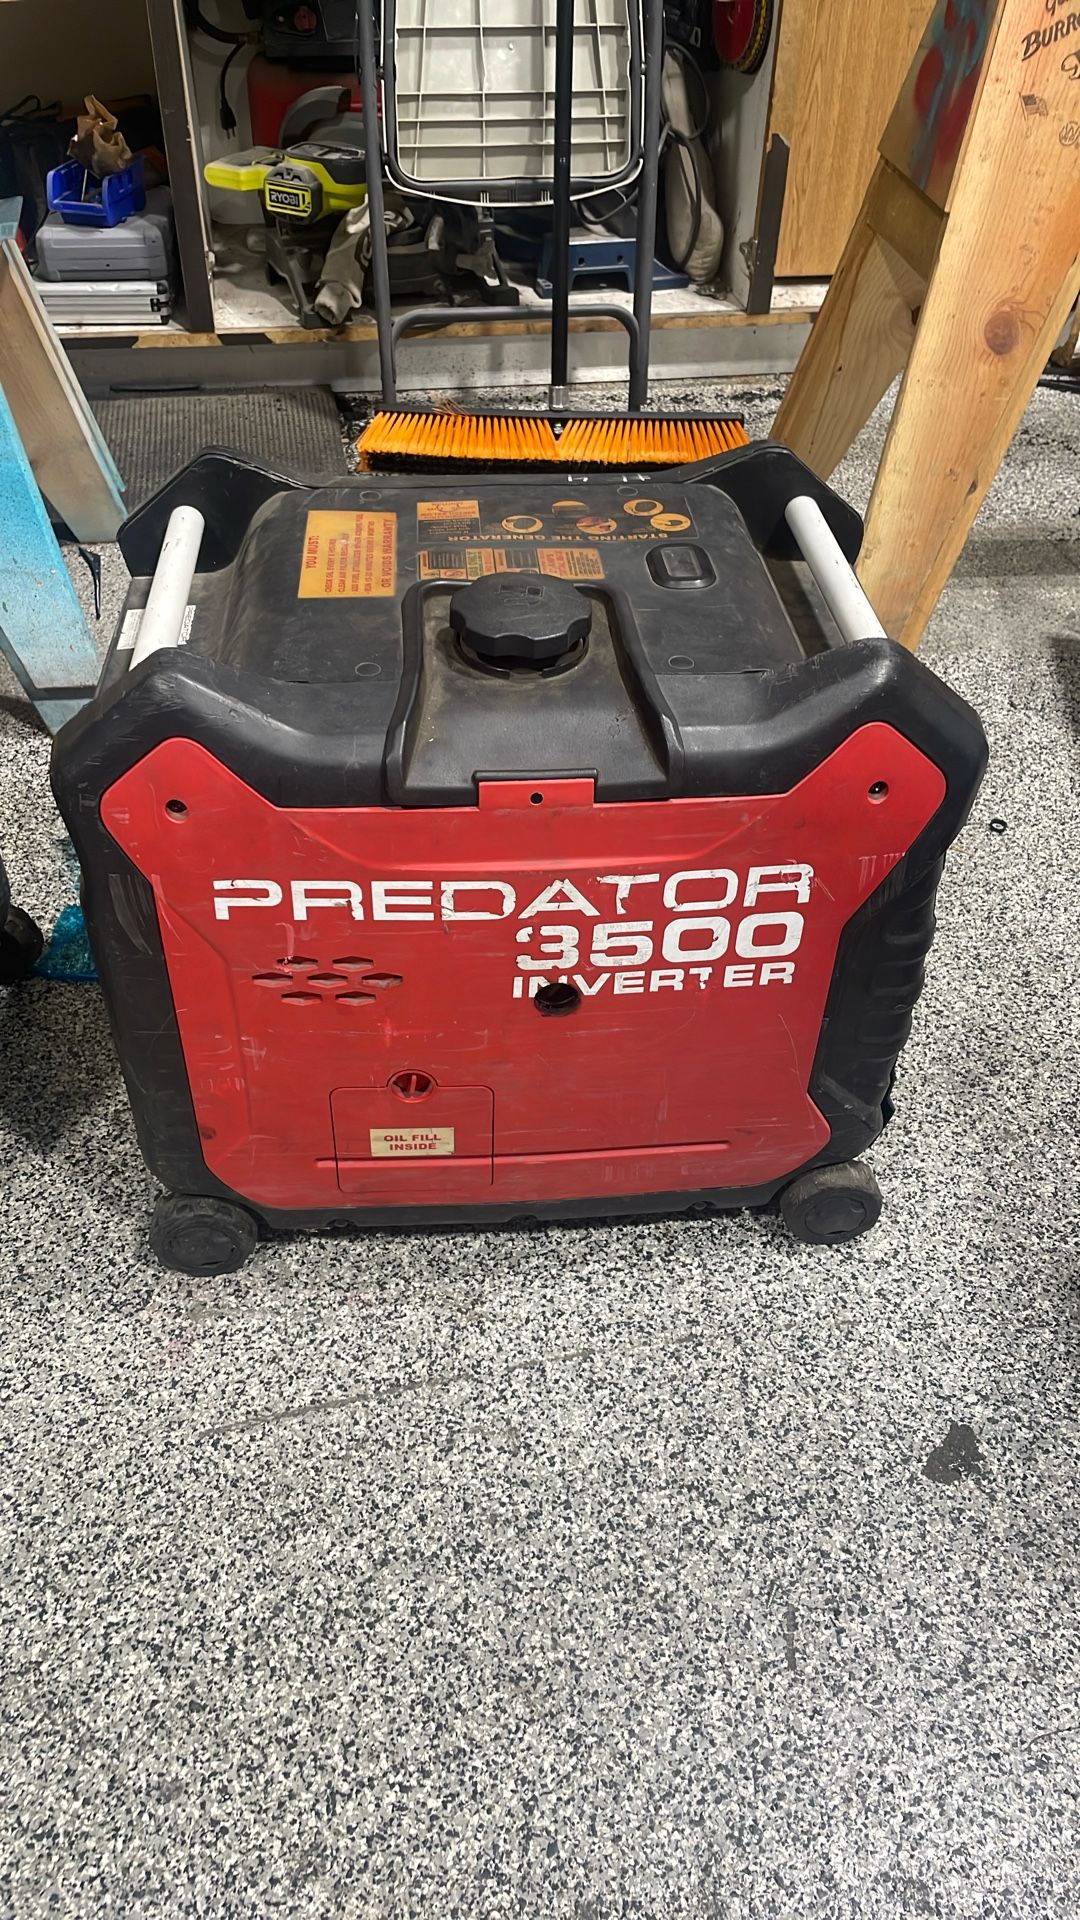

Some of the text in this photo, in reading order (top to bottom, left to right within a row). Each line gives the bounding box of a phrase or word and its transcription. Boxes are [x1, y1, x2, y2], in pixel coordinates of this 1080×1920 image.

[270, 190, 299, 206] RYOBI
[305, 535, 320, 569] YOU MUST:
[381, 519, 393, 588] OR VOIDS WARRANTY
[588, 533, 668, 541] STARTING
[213, 863, 814, 921] PREDATOR
[516, 911, 804, 971] 3500
